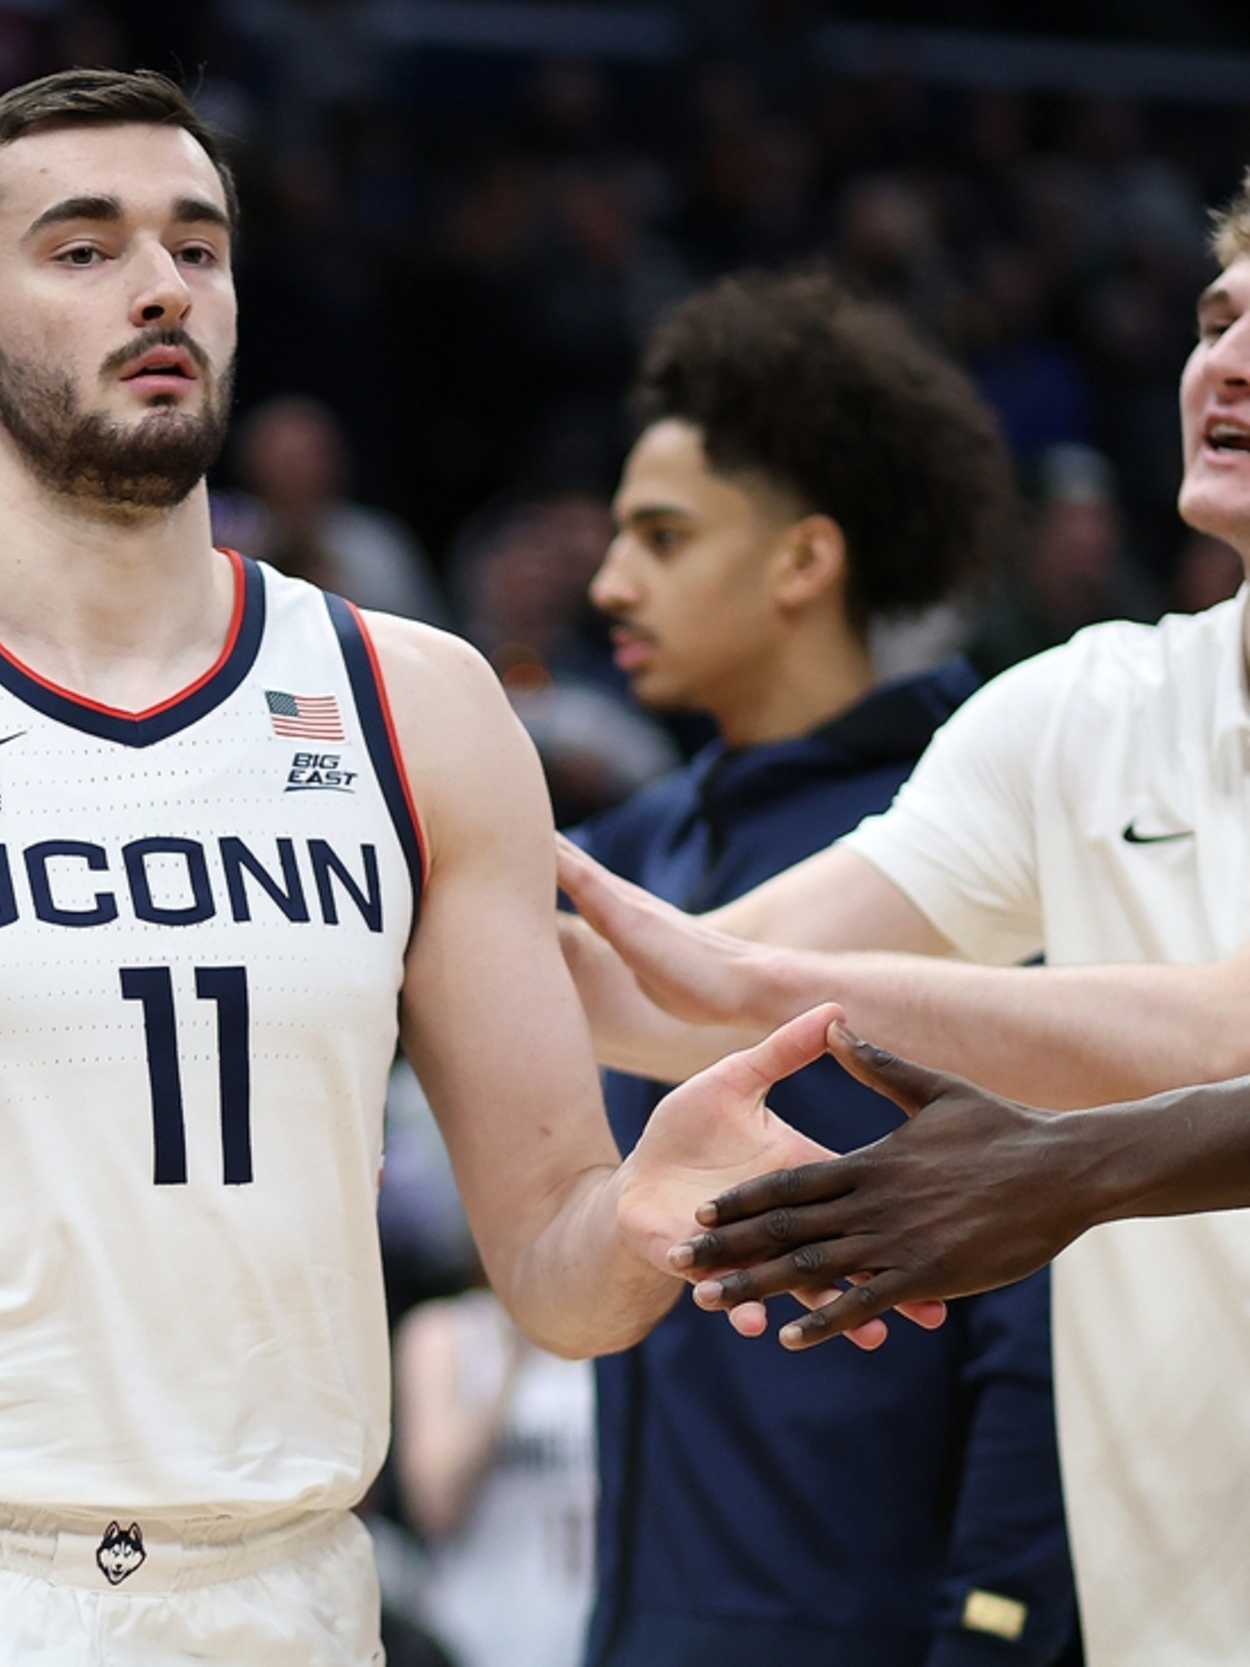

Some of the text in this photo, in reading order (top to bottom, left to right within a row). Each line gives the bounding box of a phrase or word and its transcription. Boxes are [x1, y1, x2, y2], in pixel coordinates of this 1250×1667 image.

[292, 752, 341, 769] BIG
[287, 769, 358, 786] EAST
[118, 965, 254, 1186] 11
